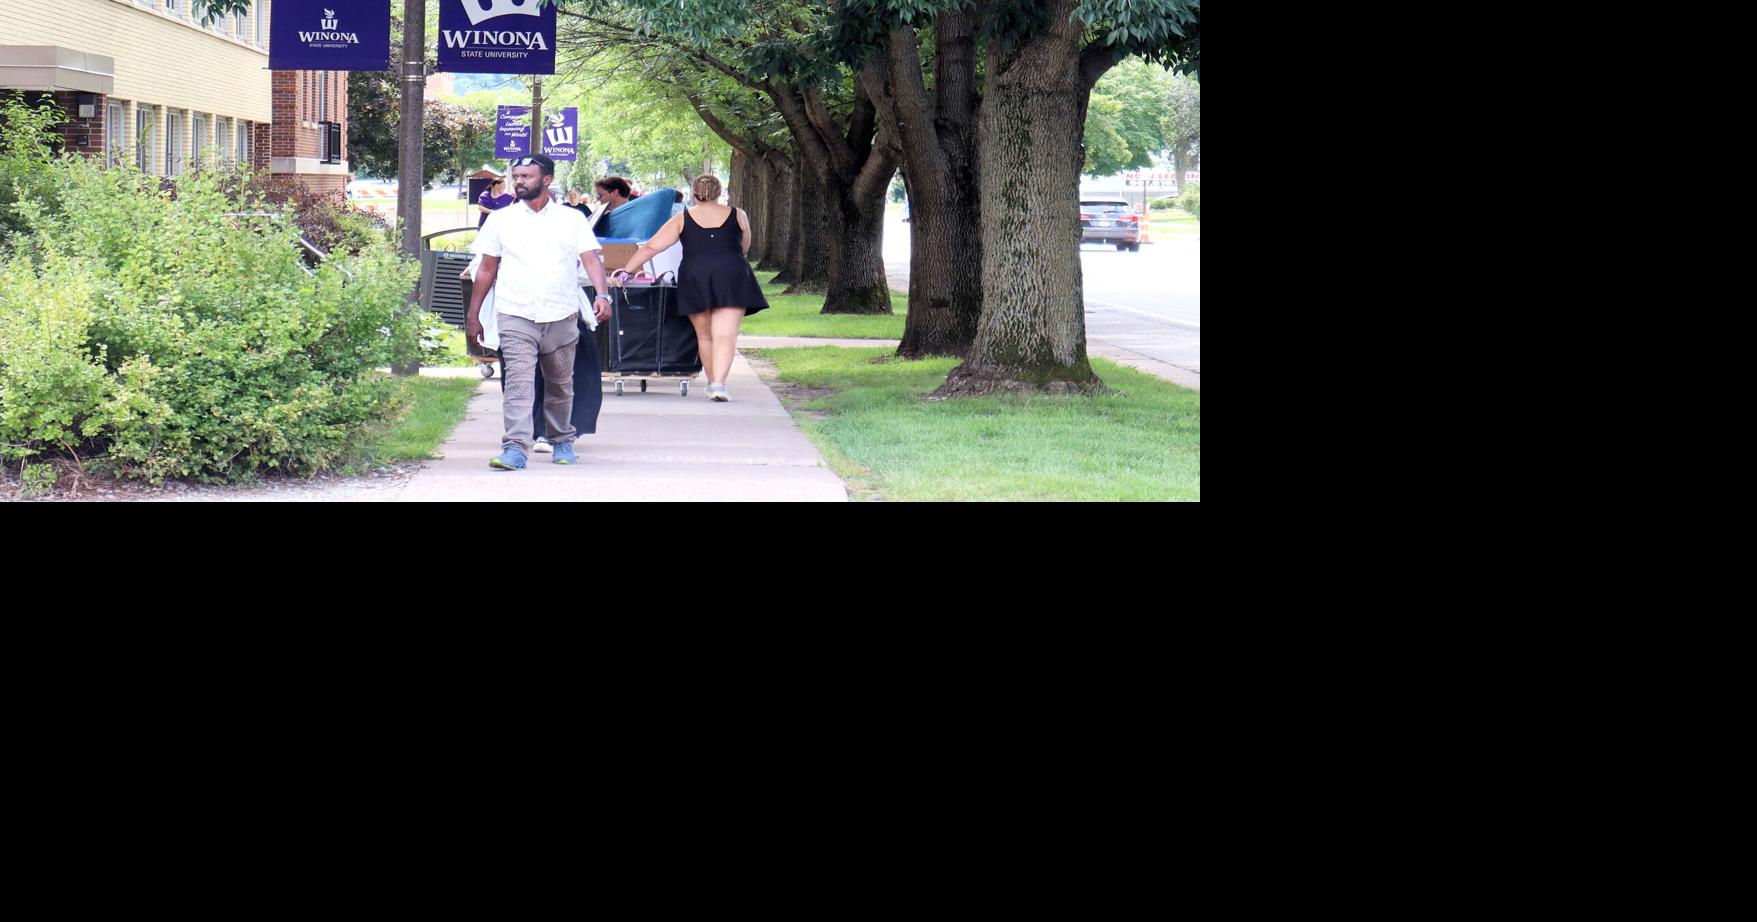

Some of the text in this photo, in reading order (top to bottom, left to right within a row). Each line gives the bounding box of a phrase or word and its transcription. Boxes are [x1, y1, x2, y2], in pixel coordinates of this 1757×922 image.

[298, 31, 359, 44] WINONA
[442, 30, 549, 50] WINONA
[485, 51, 528, 59] UNIVERSITY
[544, 147, 575, 155] WINONA
